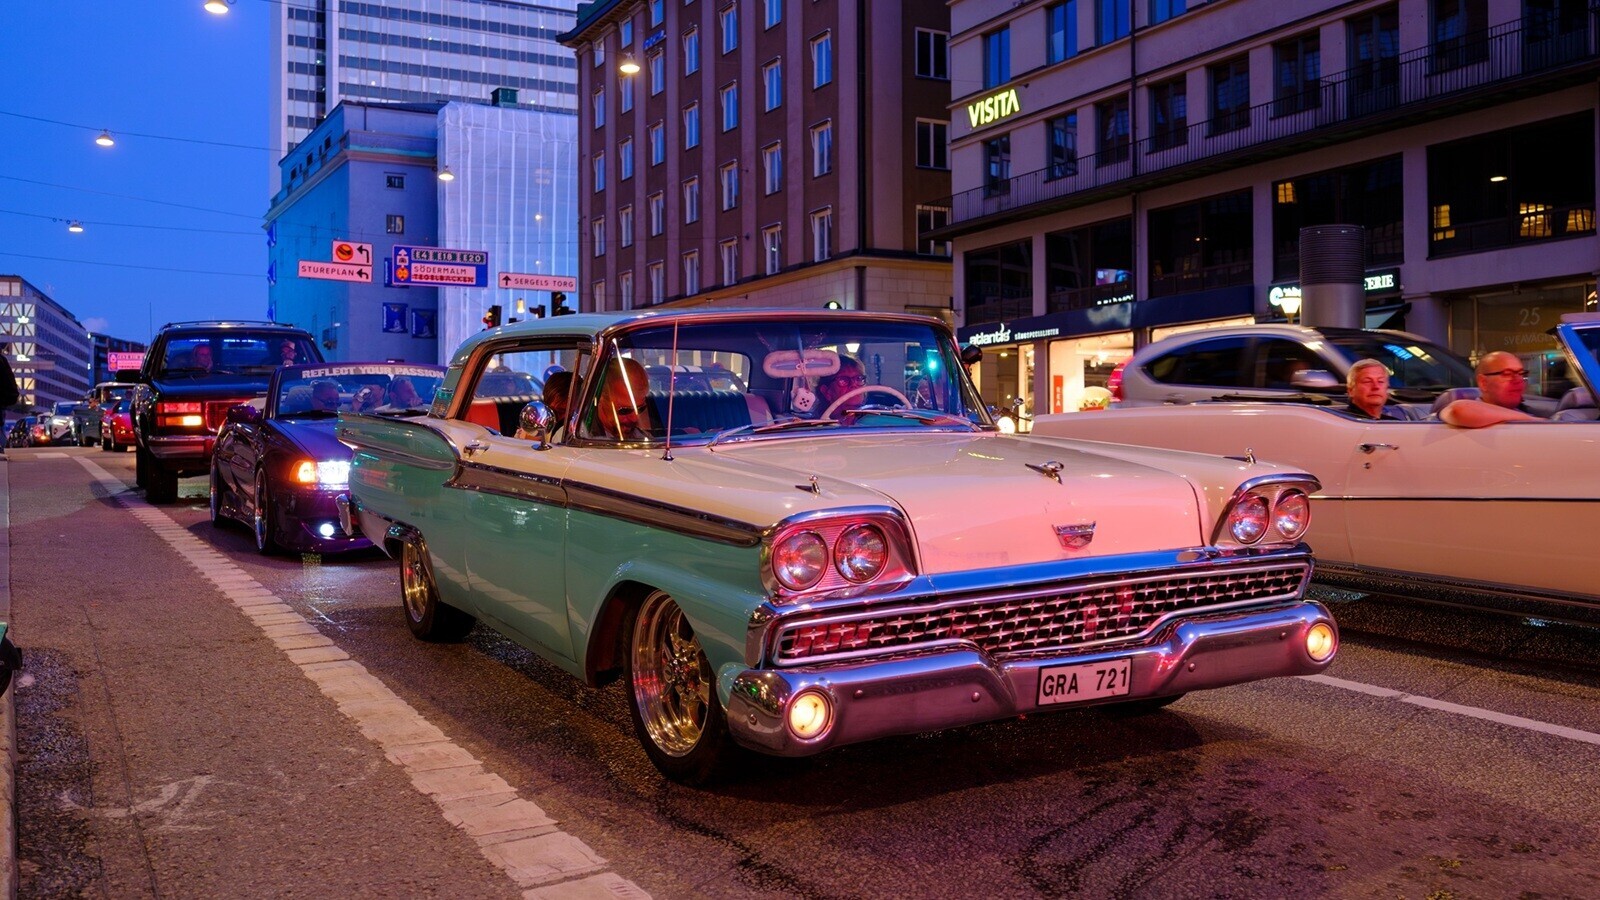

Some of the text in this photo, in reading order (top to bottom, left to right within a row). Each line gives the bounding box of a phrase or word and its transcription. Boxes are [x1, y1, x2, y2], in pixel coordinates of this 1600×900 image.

[968, 88, 1020, 128] VISITA
[415, 250, 481, 262] E4 E18 E20
[301, 265, 355, 276] STUREPLAN
[413, 265, 467, 275] SÖDERMALM
[514, 278, 574, 288] SERGELS TORG
[1519, 307, 1541, 326] 25
[969, 323, 1011, 345] atlantis
[302, 366, 445, 379] REFLECT YOUR PASSION
[1042, 666, 1128, 697] GRA 721
